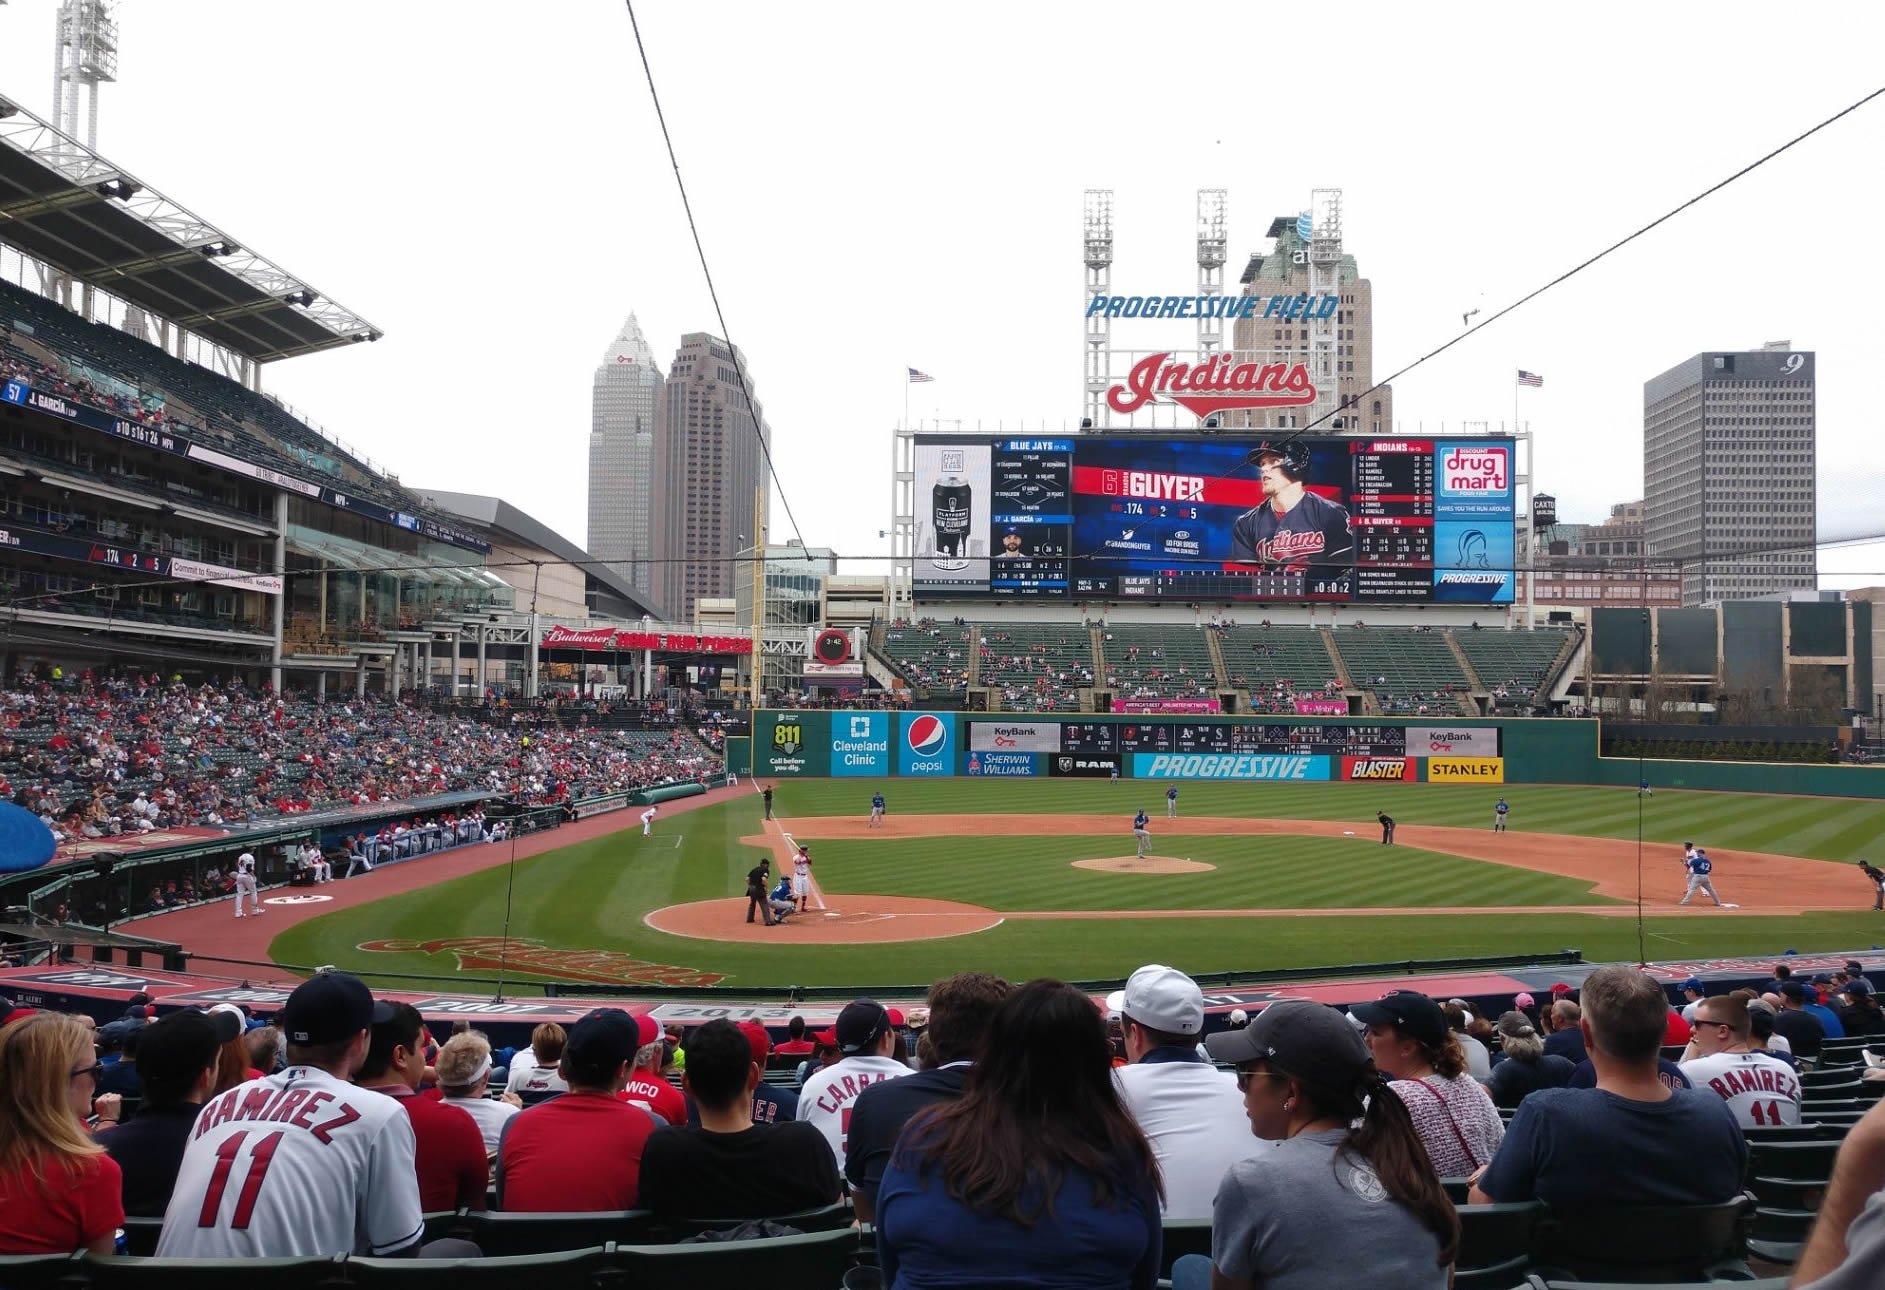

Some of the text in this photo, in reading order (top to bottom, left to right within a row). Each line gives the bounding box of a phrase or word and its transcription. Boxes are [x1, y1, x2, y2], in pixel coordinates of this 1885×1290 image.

[1085, 295, 1338, 319] PROGRESSIVE FIELD
[8, 383, 20, 401] 57
[1106, 352, 1317, 418] Indians
[29, 392, 37, 405] J.
[162, 437, 174, 450] MPH
[1010, 441, 1030, 450] BLUE
[1032, 441, 1053, 450] JAYS
[1373, 443, 1407, 452] INDIANS
[1447, 449, 1496, 475] drug
[1102, 470, 1118, 495] 6
[1130, 472, 1205, 502] GUYER
[1451, 474, 1506, 489] mart
[1123, 502, 1143, 515] .174
[1160, 506, 1167, 517] 2
[1190, 507, 1197, 519] 5
[1256, 529, 1325, 562] Indians
[173, 562, 198, 575] Commit
[198, 567, 205, 576] to
[1440, 573, 1508, 584] PROGRESSIVE
[549, 630, 609, 643] Budweiser
[775, 725, 800, 744] 811
[994, 728, 1036, 737] KeyBank
[1429, 732, 1472, 742] KeyBank
[833, 740, 887, 752] Cleveland
[844, 754, 876, 766] Clinic
[984, 754, 1030, 764] SHERWIN
[911, 761, 943, 773] pepsi
[1148, 756, 1312, 778] PROGRESSIVE
[1351, 760, 1405, 778] BLASTER
[1432, 764, 1498, 776] STANLEY
[417, 1001, 548, 1014] 2007
[670, 1008, 792, 1017] 2013
[621, 1081, 659, 1098] WCO
[1751, 1100, 1781, 1126] 11
[198, 1130, 284, 1230] 11
